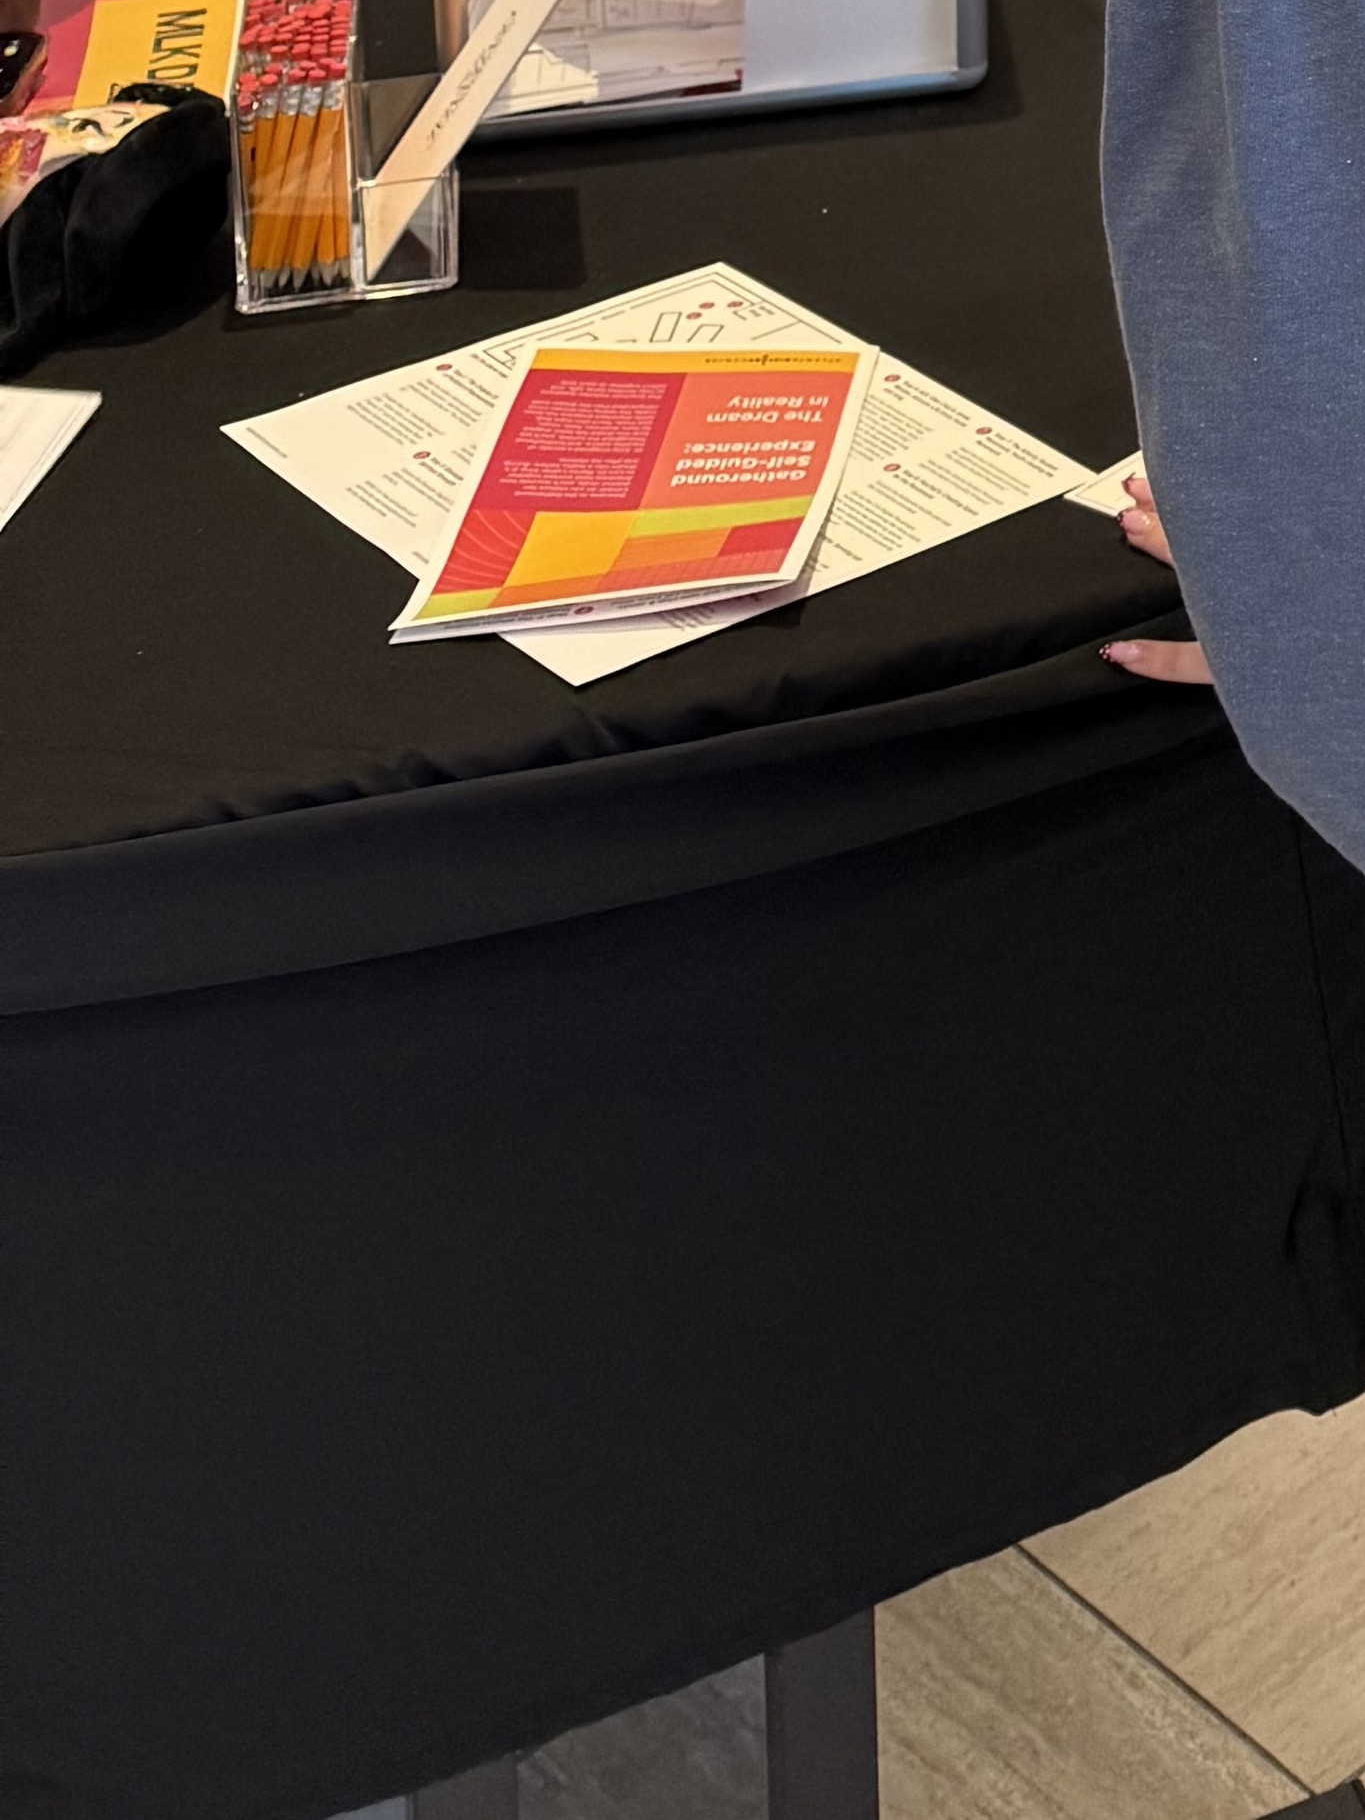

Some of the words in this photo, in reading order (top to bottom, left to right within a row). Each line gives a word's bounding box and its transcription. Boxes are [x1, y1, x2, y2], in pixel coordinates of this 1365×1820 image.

[148, 8, 209, 65] MLK
[727, 395, 803, 409] Reality
[707, 411, 779, 425] Dream
[784, 411, 823, 425] The
[684, 439, 815, 455] Experience:
[676, 455, 811, 470] Self-Guided
[670, 469, 806, 488] Gatheround
